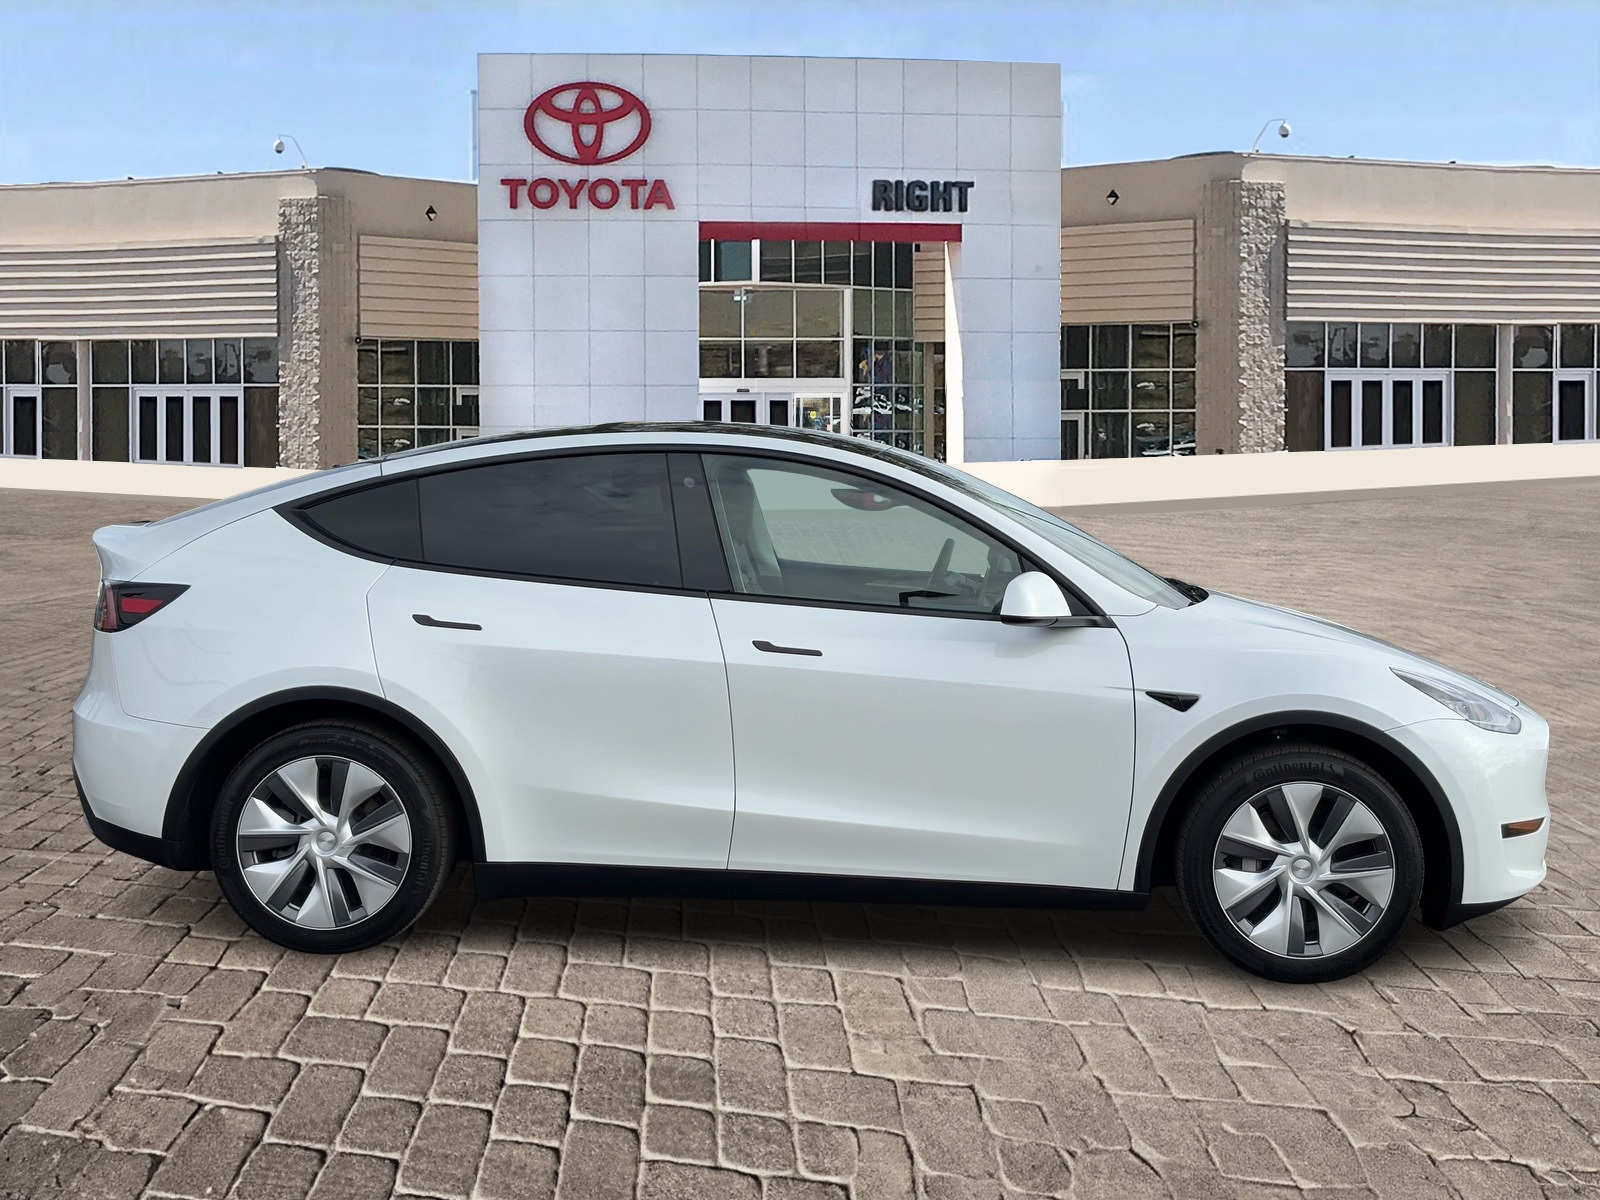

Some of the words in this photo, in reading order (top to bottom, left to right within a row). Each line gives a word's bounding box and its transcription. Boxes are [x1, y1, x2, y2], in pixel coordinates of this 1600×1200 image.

[500, 178, 675, 210] TOYOTA
[872, 179, 975, 212] RIGHT
[1252, 760, 1325, 780] Continental
